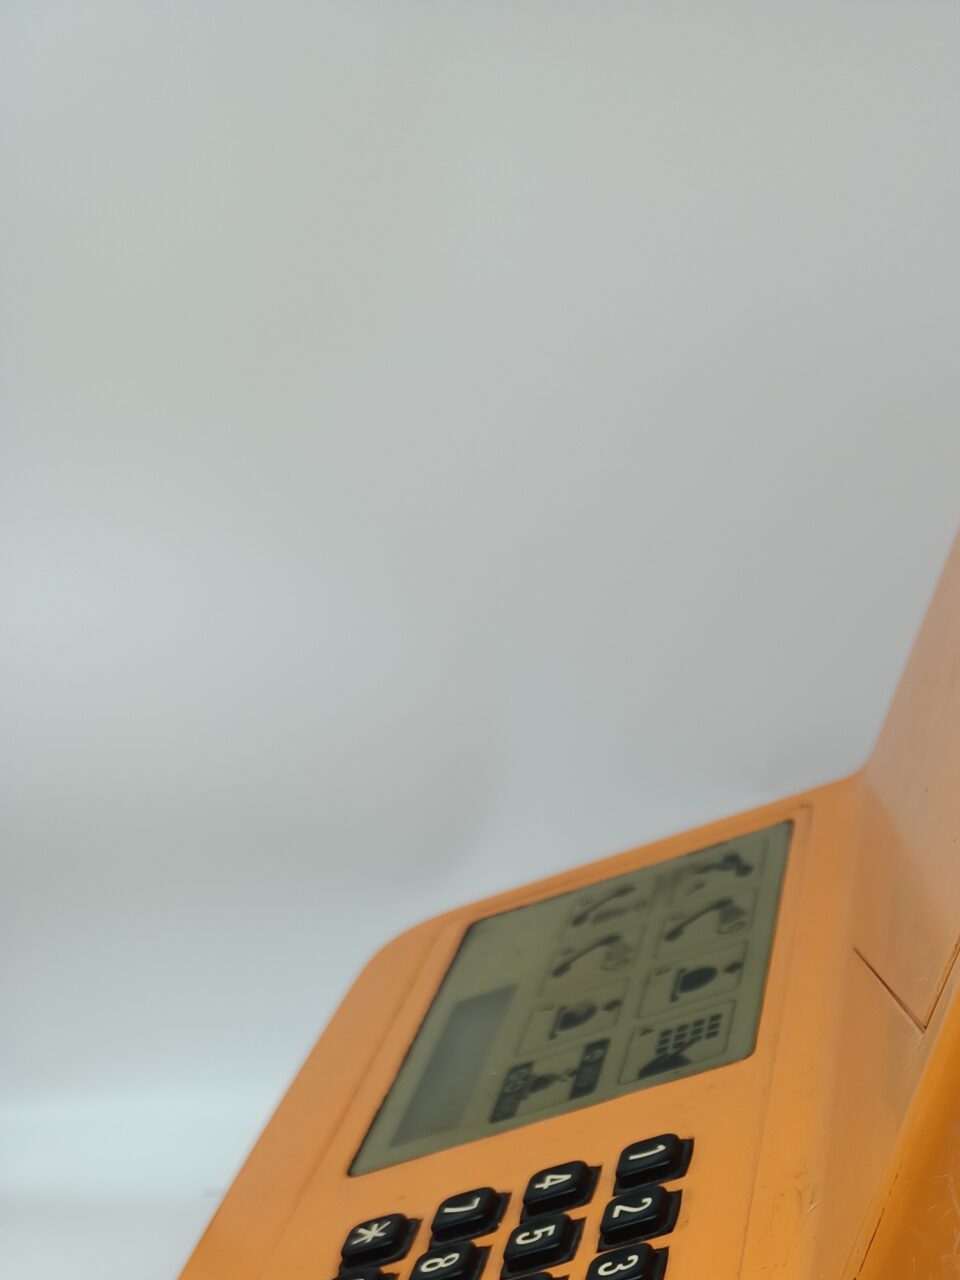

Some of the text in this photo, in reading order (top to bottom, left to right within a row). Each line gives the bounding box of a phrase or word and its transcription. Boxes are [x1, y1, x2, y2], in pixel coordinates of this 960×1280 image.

[534, 1172, 573, 1190] 4
[443, 1197, 481, 1214] 7
[597, 1143, 667, 1276] 1 2 3
[515, 1223, 556, 1246] 5
[419, 1252, 460, 1273] 8
